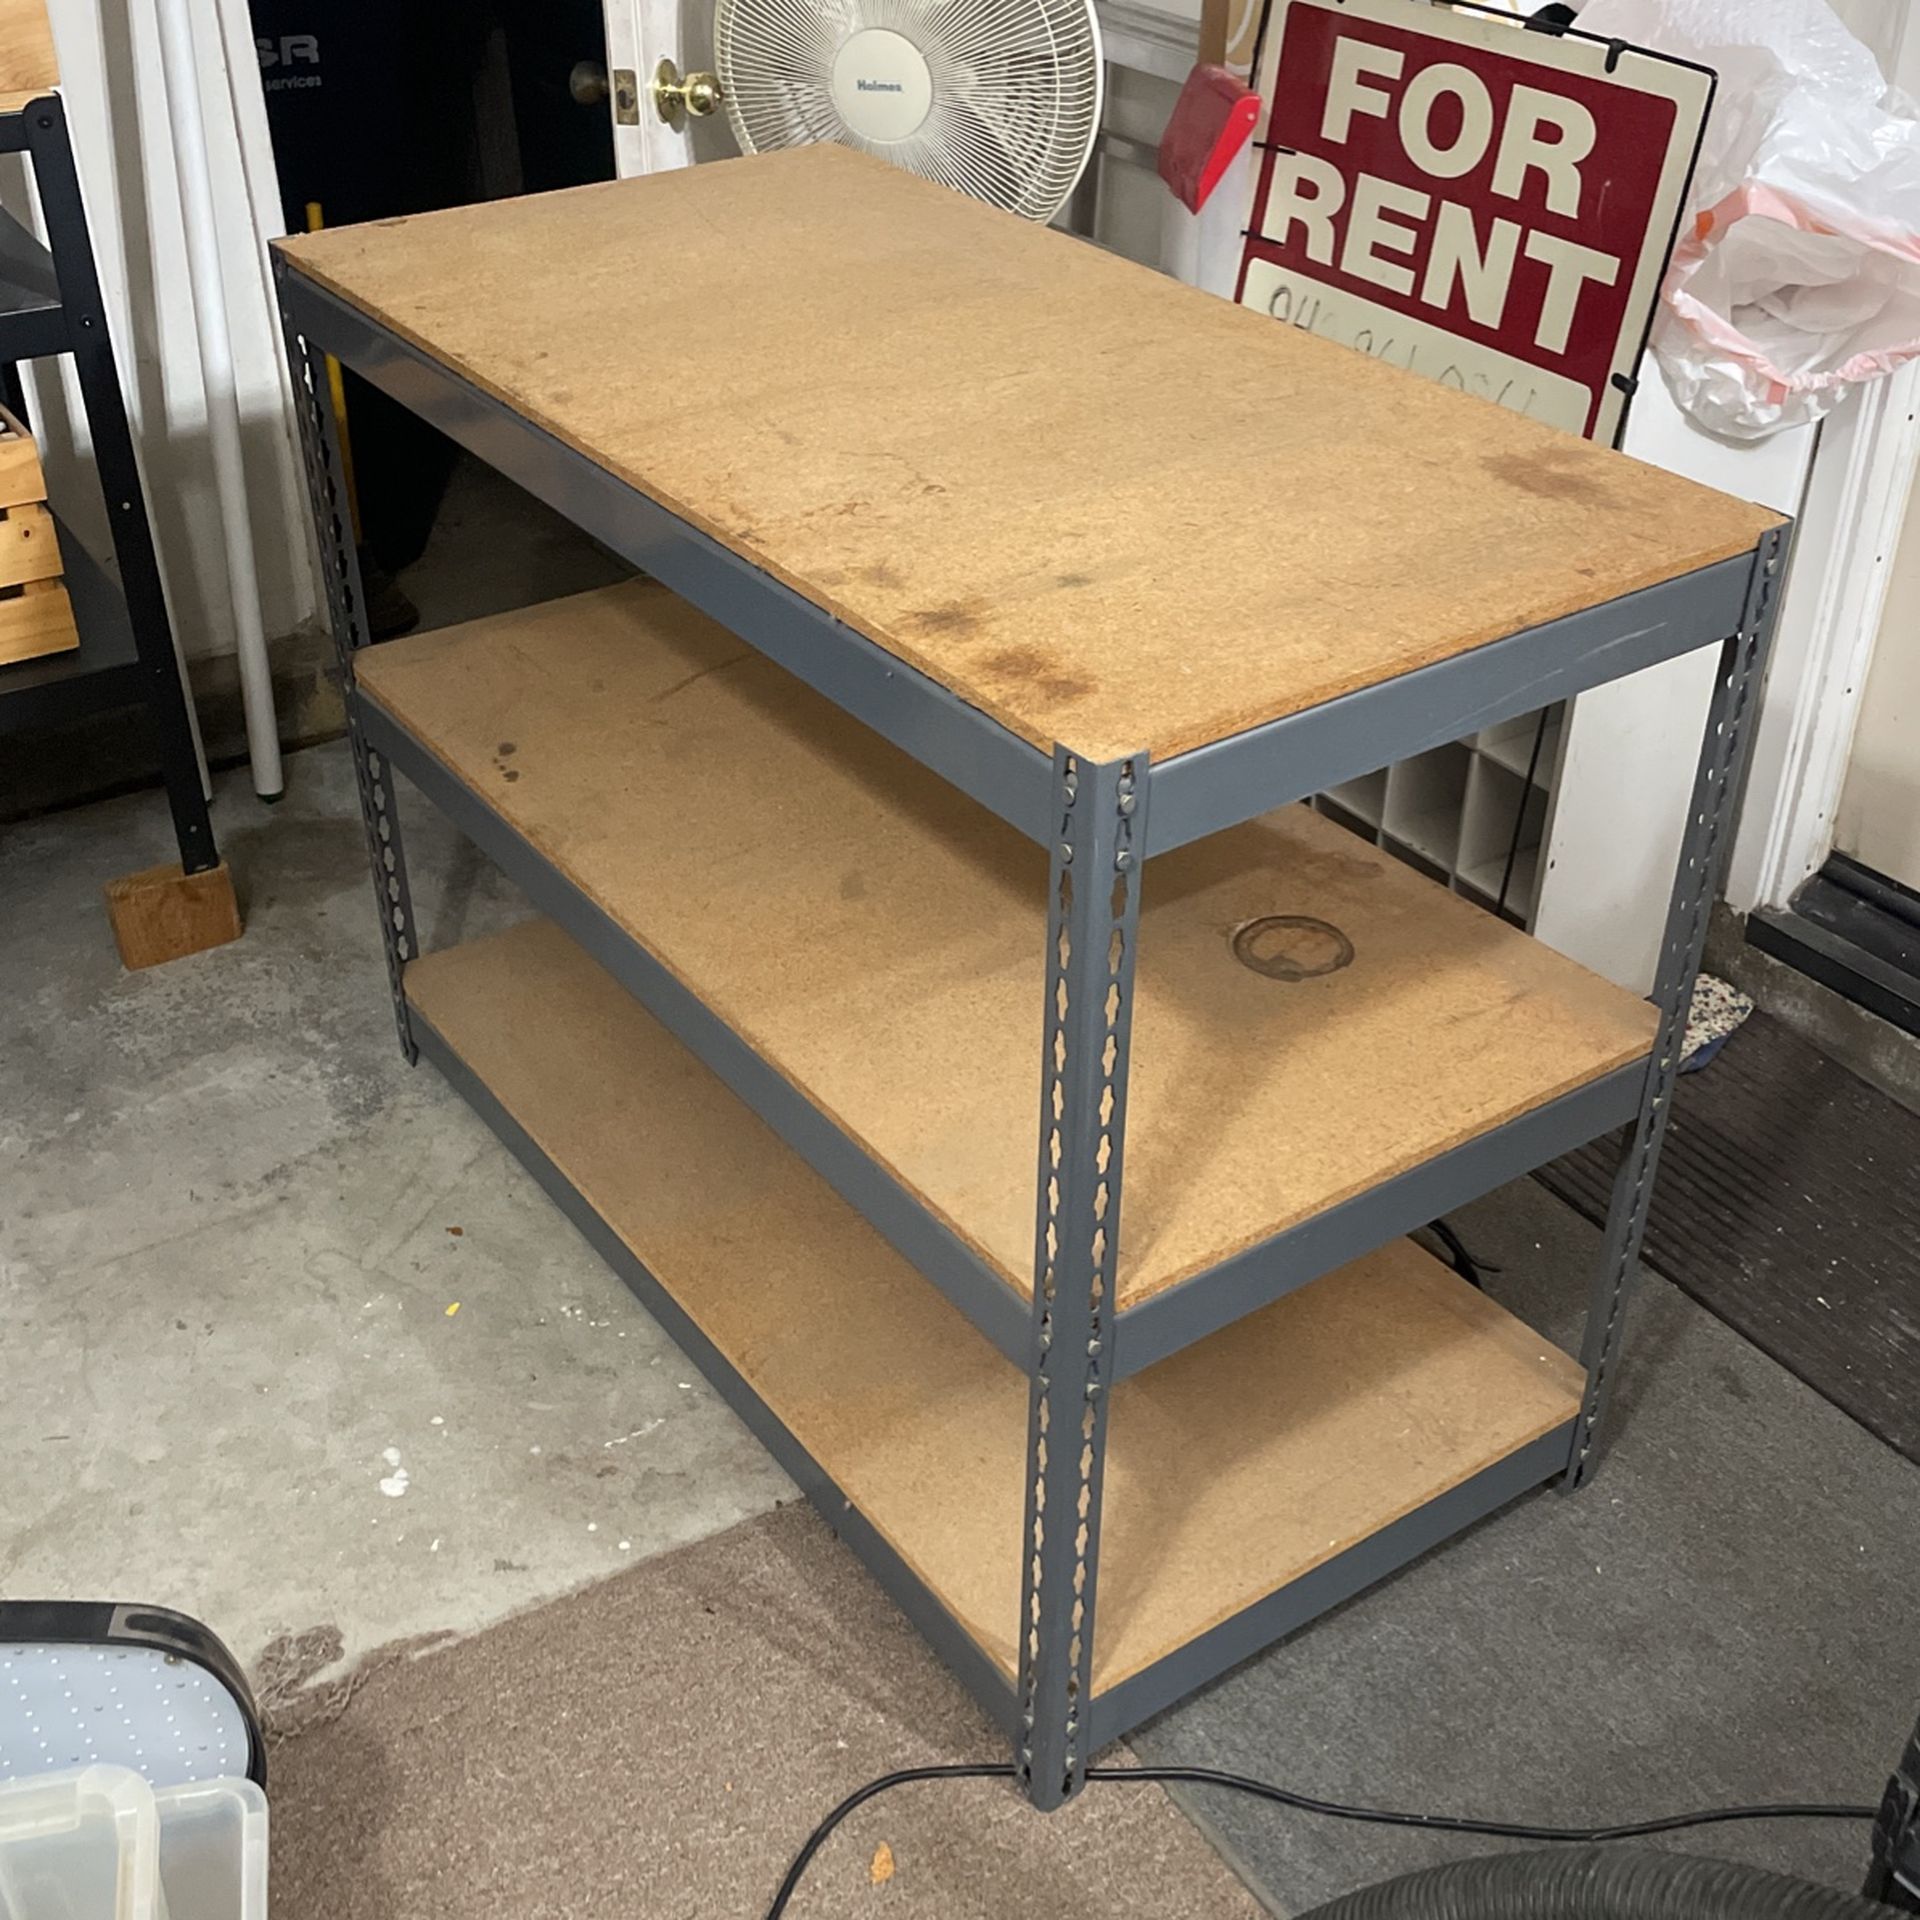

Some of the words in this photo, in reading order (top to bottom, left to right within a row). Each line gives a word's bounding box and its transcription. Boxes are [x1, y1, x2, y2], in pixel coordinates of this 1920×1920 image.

[857, 79, 902, 92] Holmes
[1320, 35, 1597, 219] FOR
[1260, 145, 1621, 355] RENT
